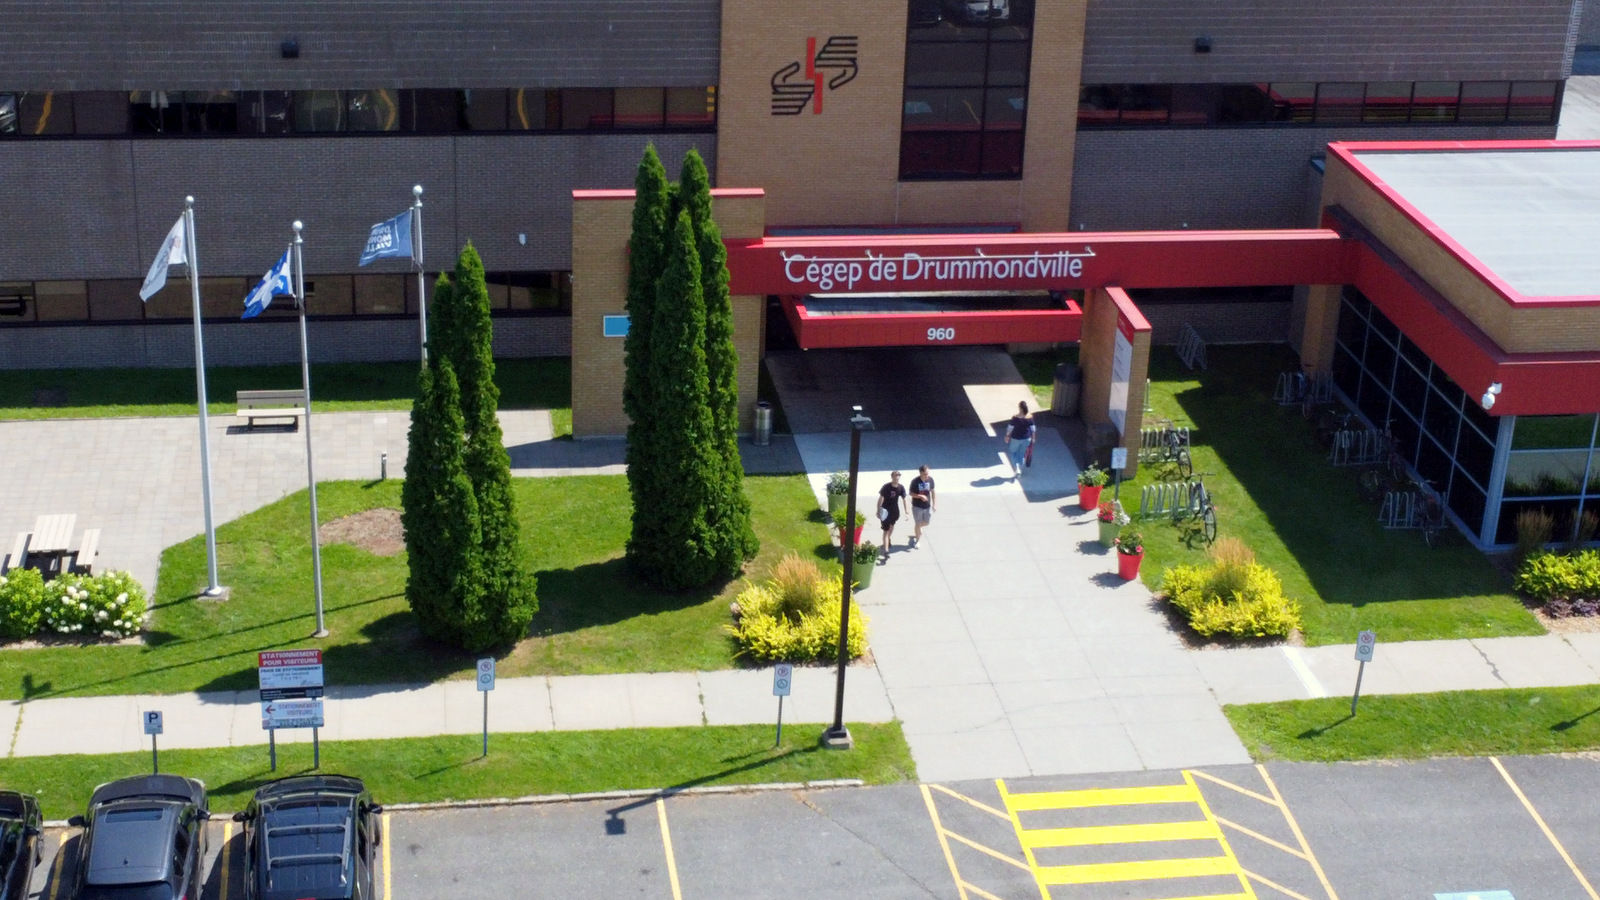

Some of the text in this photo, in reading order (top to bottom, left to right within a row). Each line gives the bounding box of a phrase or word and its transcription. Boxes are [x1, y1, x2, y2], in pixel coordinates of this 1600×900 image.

[784, 251, 1082, 290] Cégep de Drummondville
[927, 327, 955, 341] 960
[261, 651, 318, 659] STATIONNEMENT
